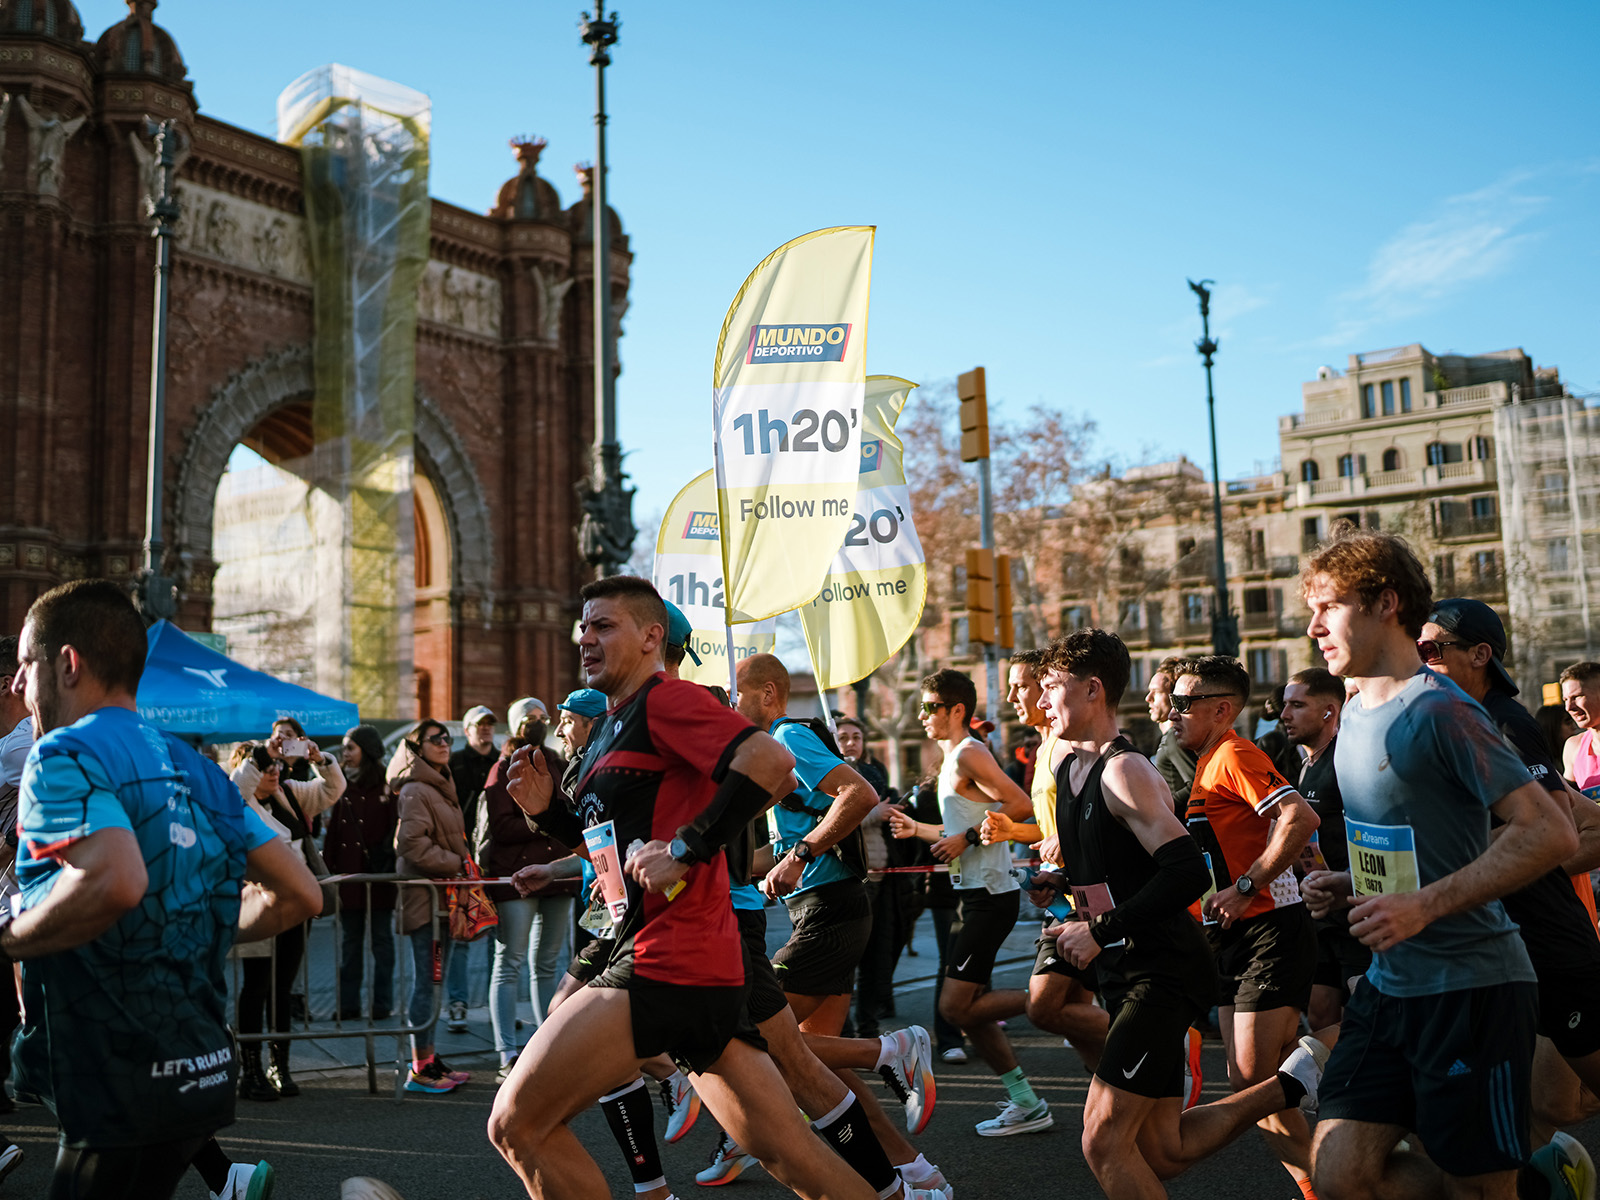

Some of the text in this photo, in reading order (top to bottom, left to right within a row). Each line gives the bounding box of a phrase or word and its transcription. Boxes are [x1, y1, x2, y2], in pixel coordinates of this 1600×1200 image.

[757, 327, 845, 347] MUNDO
[754, 346, 823, 357] DEPORTIVO
[733, 408, 857, 455] 1h20'
[740, 495, 815, 521] Follow
[822, 498, 848, 516] me
[844, 506, 905, 547] 20'
[669, 572, 725, 609] 1h2
[876, 579, 907, 597] me
[690, 637, 758, 659] llow me
[1362, 832, 1390, 845] eDreams
[1358, 851, 1387, 877] LEON
[151, 1058, 196, 1077] LET'S
[195, 1052, 218, 1071] RUN
[199, 1071, 228, 1089] BROOKS
